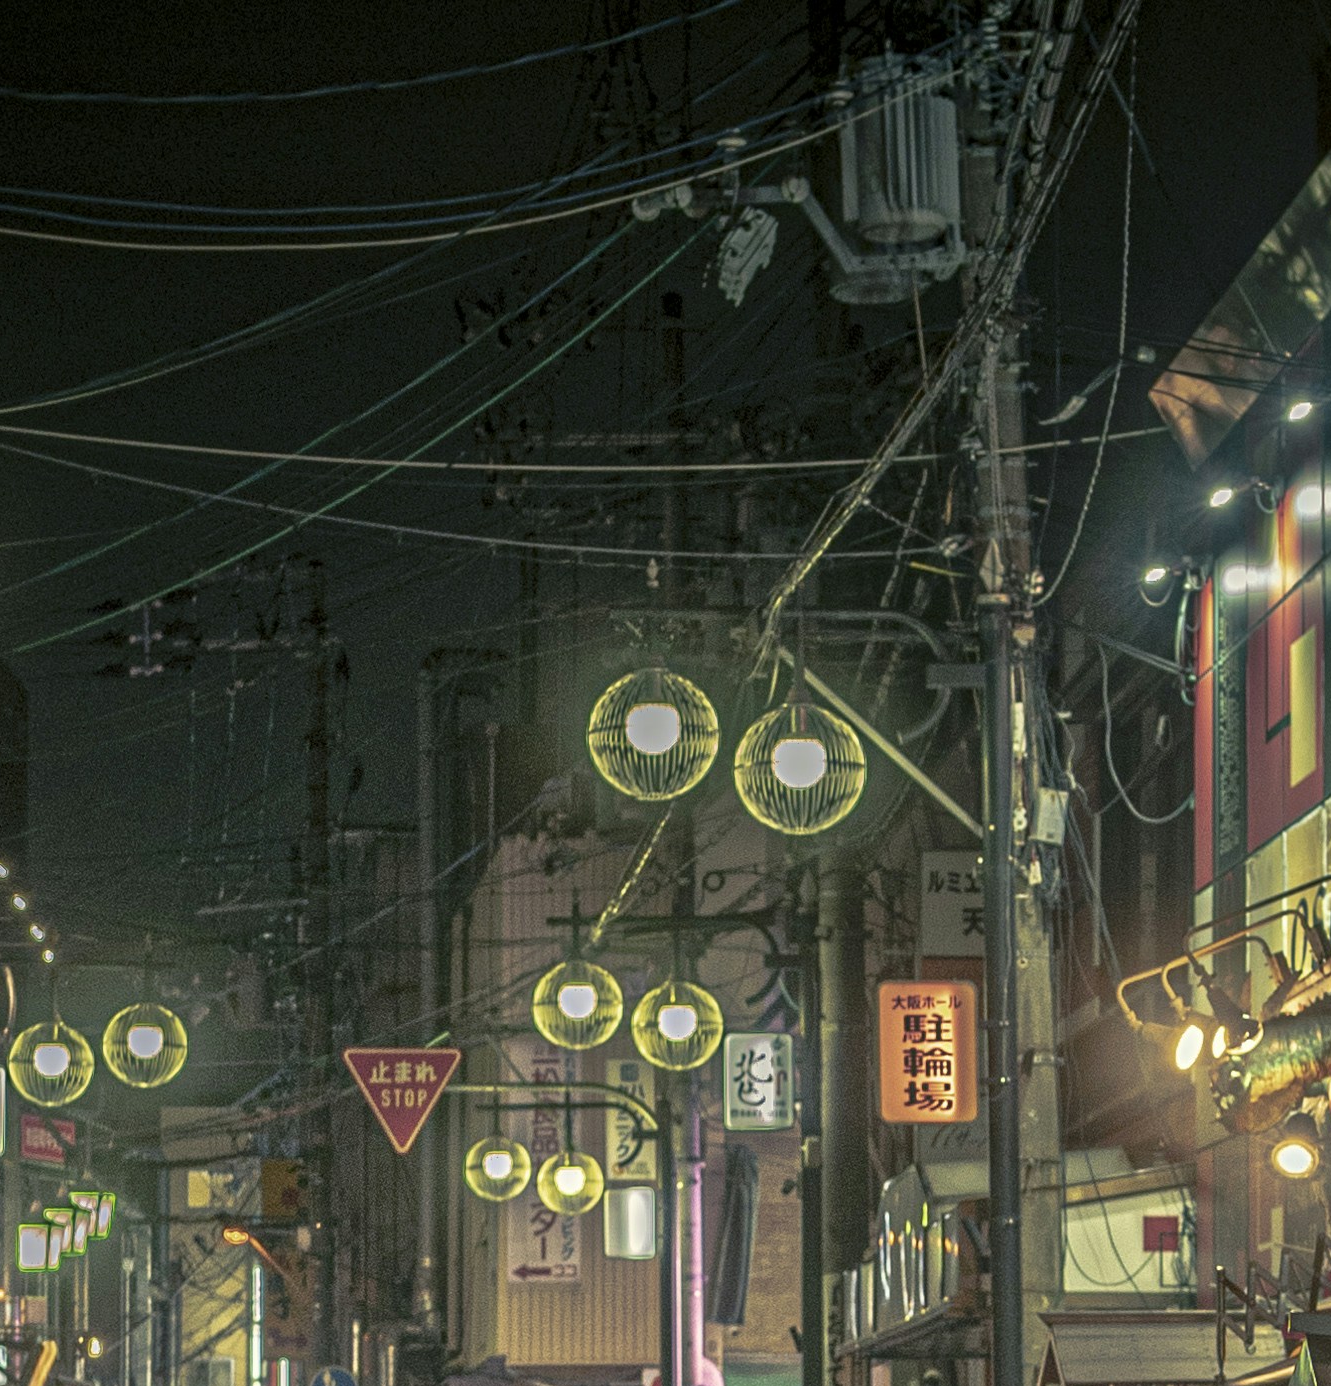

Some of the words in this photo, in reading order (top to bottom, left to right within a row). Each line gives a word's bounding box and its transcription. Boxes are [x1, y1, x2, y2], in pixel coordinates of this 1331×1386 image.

[892, 995, 962, 1010] 大阪ホール
[370, 1060, 437, 1083] 止まれ
[902, 1013, 955, 1111] 駐輪場
[381, 1088, 427, 1108] STOP
